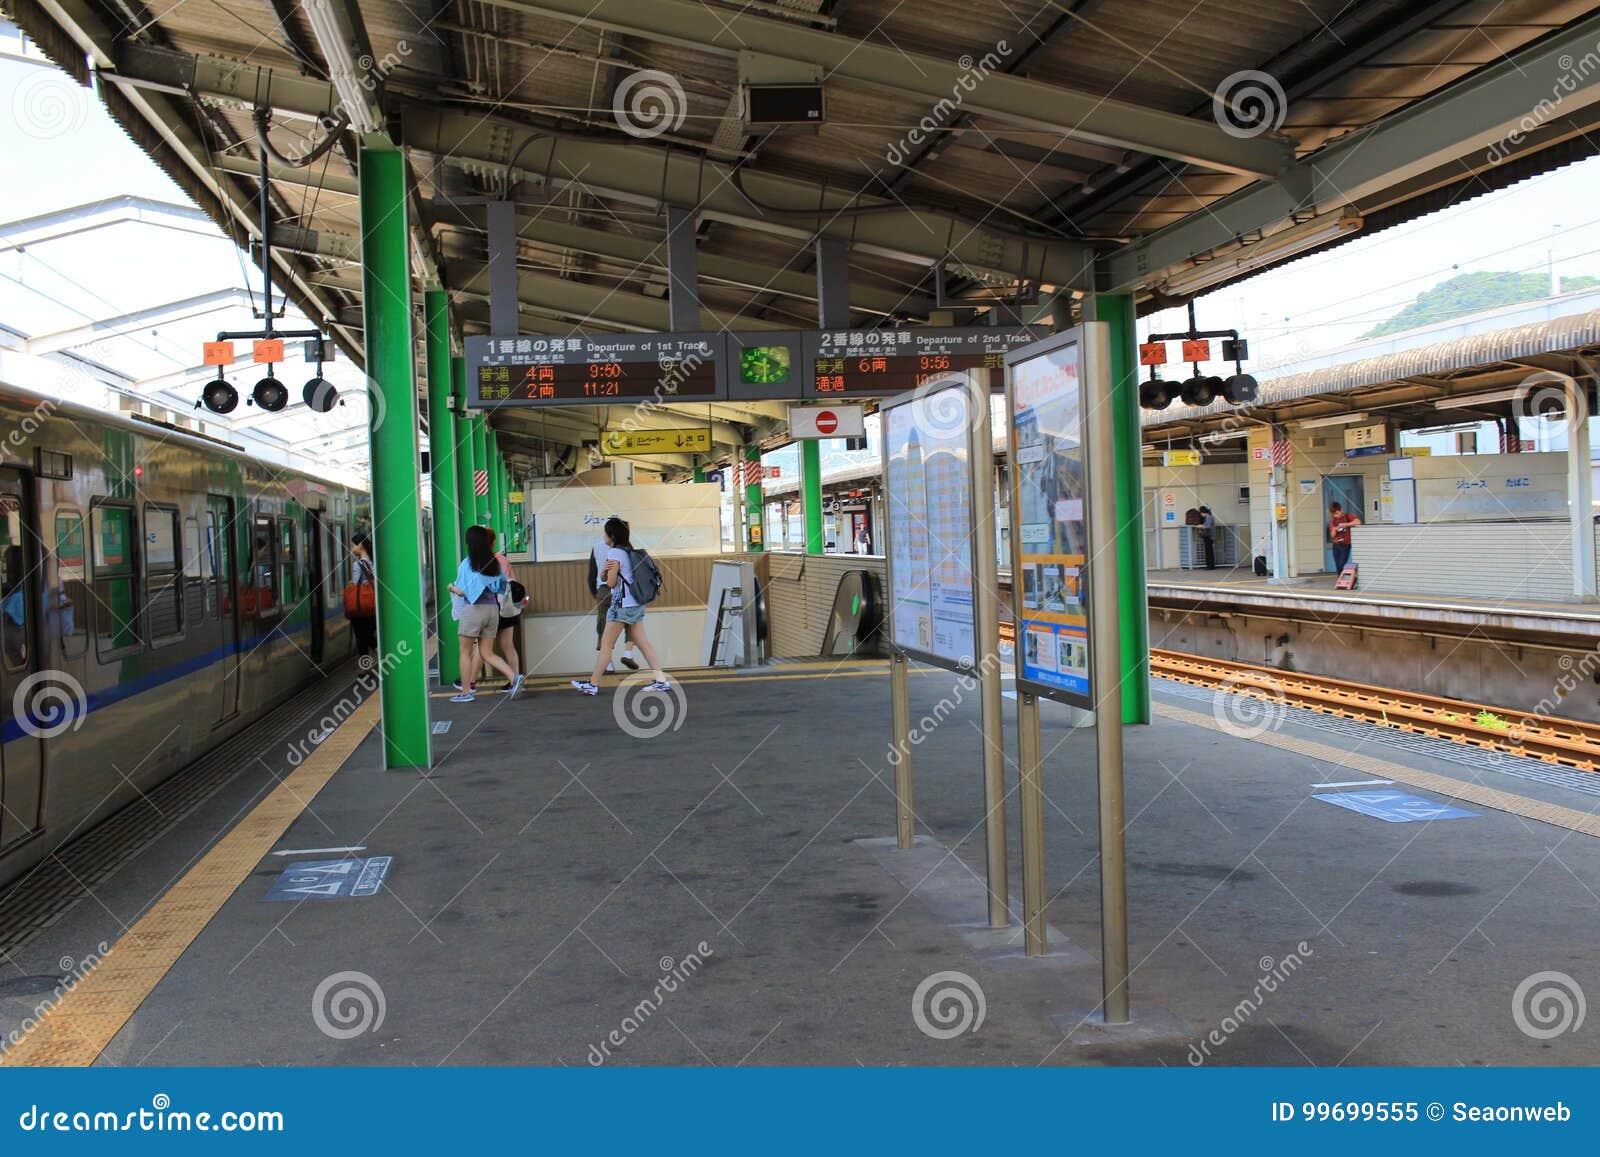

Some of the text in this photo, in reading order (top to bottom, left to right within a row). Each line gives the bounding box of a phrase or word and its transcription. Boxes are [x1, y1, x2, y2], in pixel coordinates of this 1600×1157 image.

[488, 339, 582, 354] 1番線の発車
[821, 332, 912, 347] 2番線の発車
[916, 333, 1031, 347] Departure of 2nd Track
[587, 341, 707, 355] Departure of 1st Track
[816, 359, 844, 373] 普通
[859, 358, 886, 373] 6両
[920, 356, 950, 369] 9:56
[480, 364, 620, 381] 普通 4両 9:50
[481, 382, 618, 399] 普通 2両 11:21
[816, 376, 844, 392] 通過
[1456, 480, 1487, 489] ジュース
